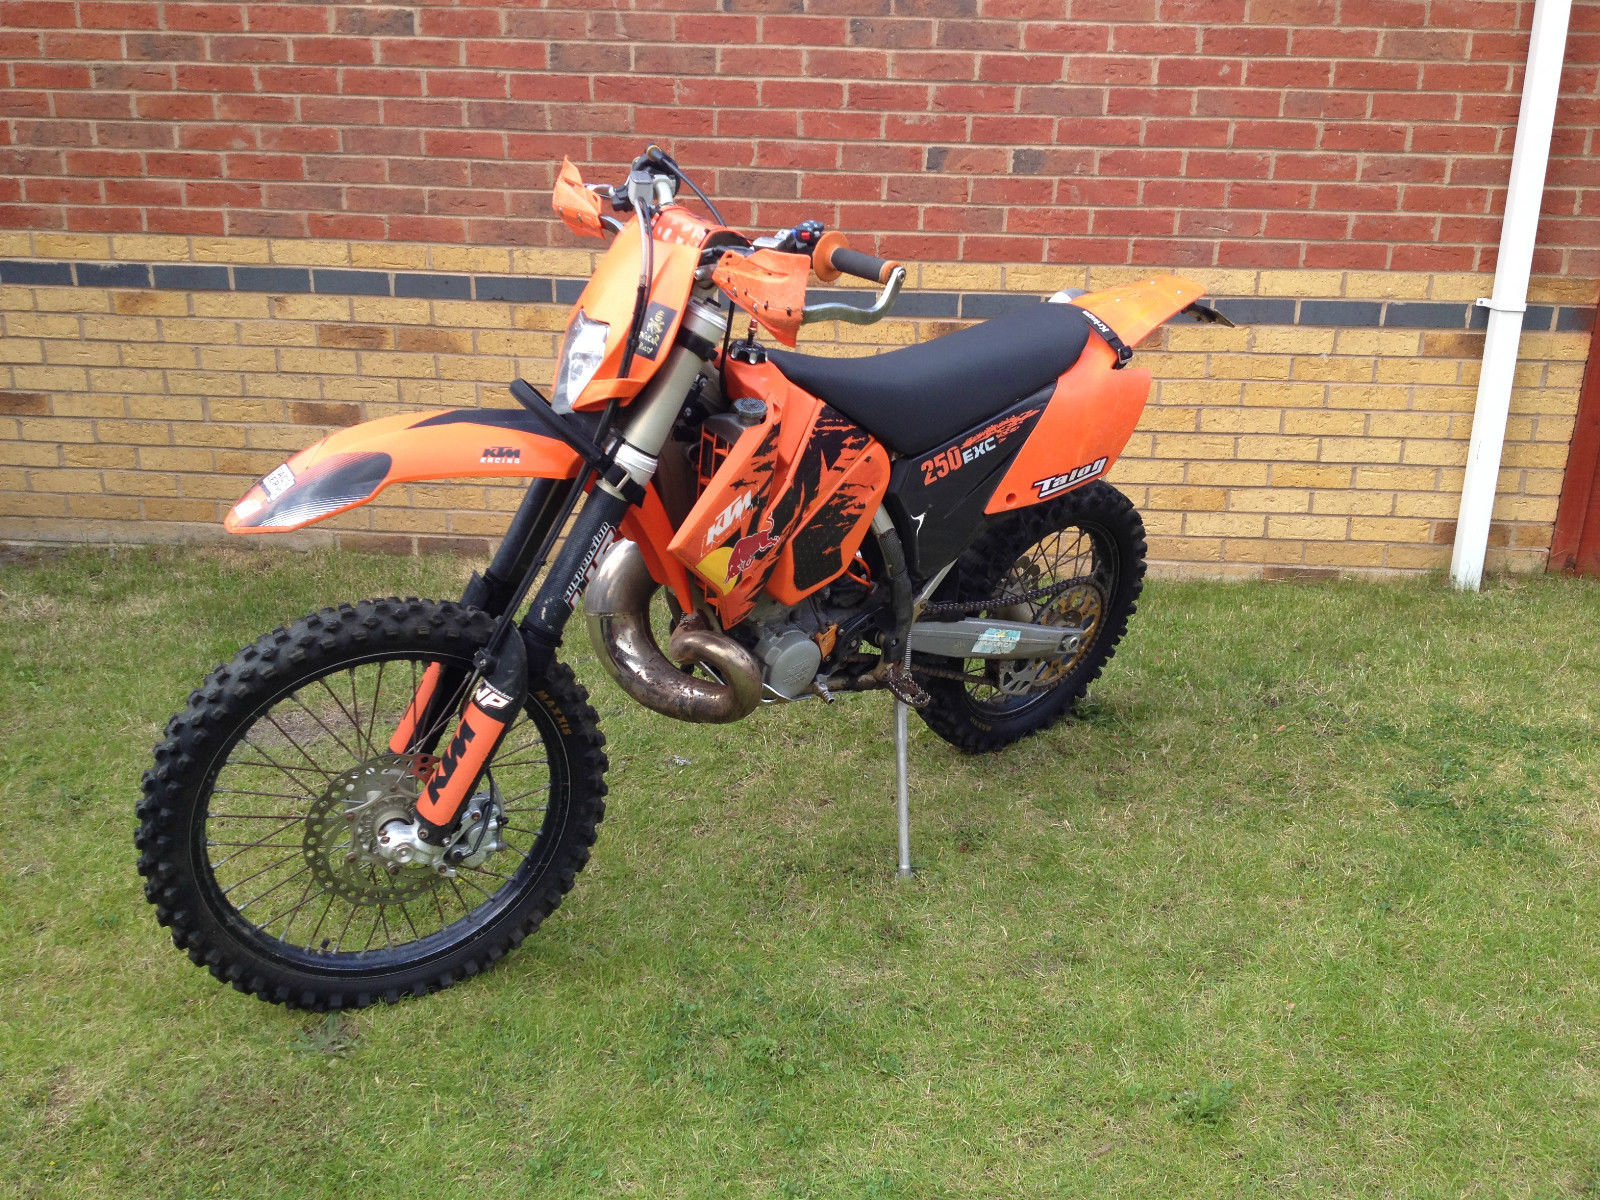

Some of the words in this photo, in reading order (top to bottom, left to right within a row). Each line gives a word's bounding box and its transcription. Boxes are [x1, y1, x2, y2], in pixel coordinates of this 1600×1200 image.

[482, 446, 521, 458] KTM
[921, 445, 963, 486] 250
[962, 436, 997, 464] EXC
[706, 489, 752, 546] KTM
[427, 718, 476, 806] KTM
